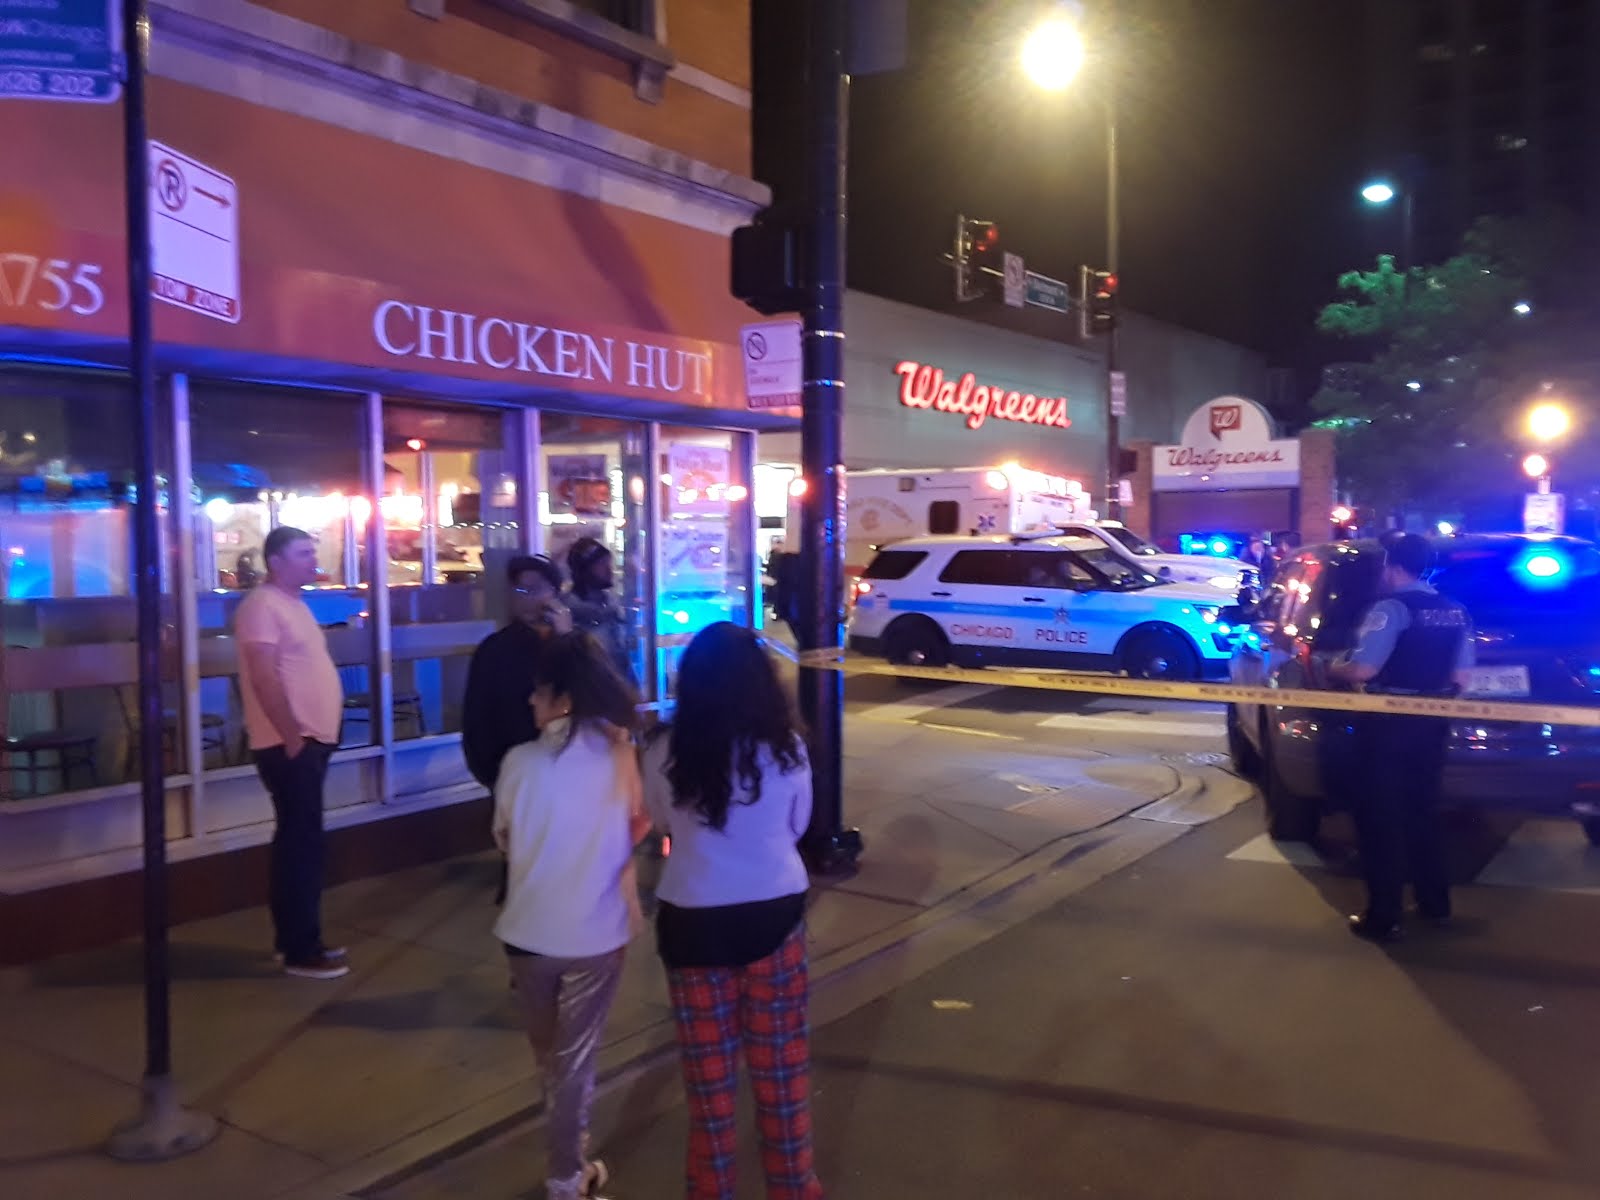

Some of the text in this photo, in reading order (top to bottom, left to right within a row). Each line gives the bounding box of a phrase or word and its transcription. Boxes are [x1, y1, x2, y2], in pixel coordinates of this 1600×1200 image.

[373, 299, 712, 396] CHICKEN HUT
[894, 360, 1072, 430] Walgreens
[1167, 447, 1284, 472] Walgreens
[950, 623, 1088, 645] CHICAGO POLICE
